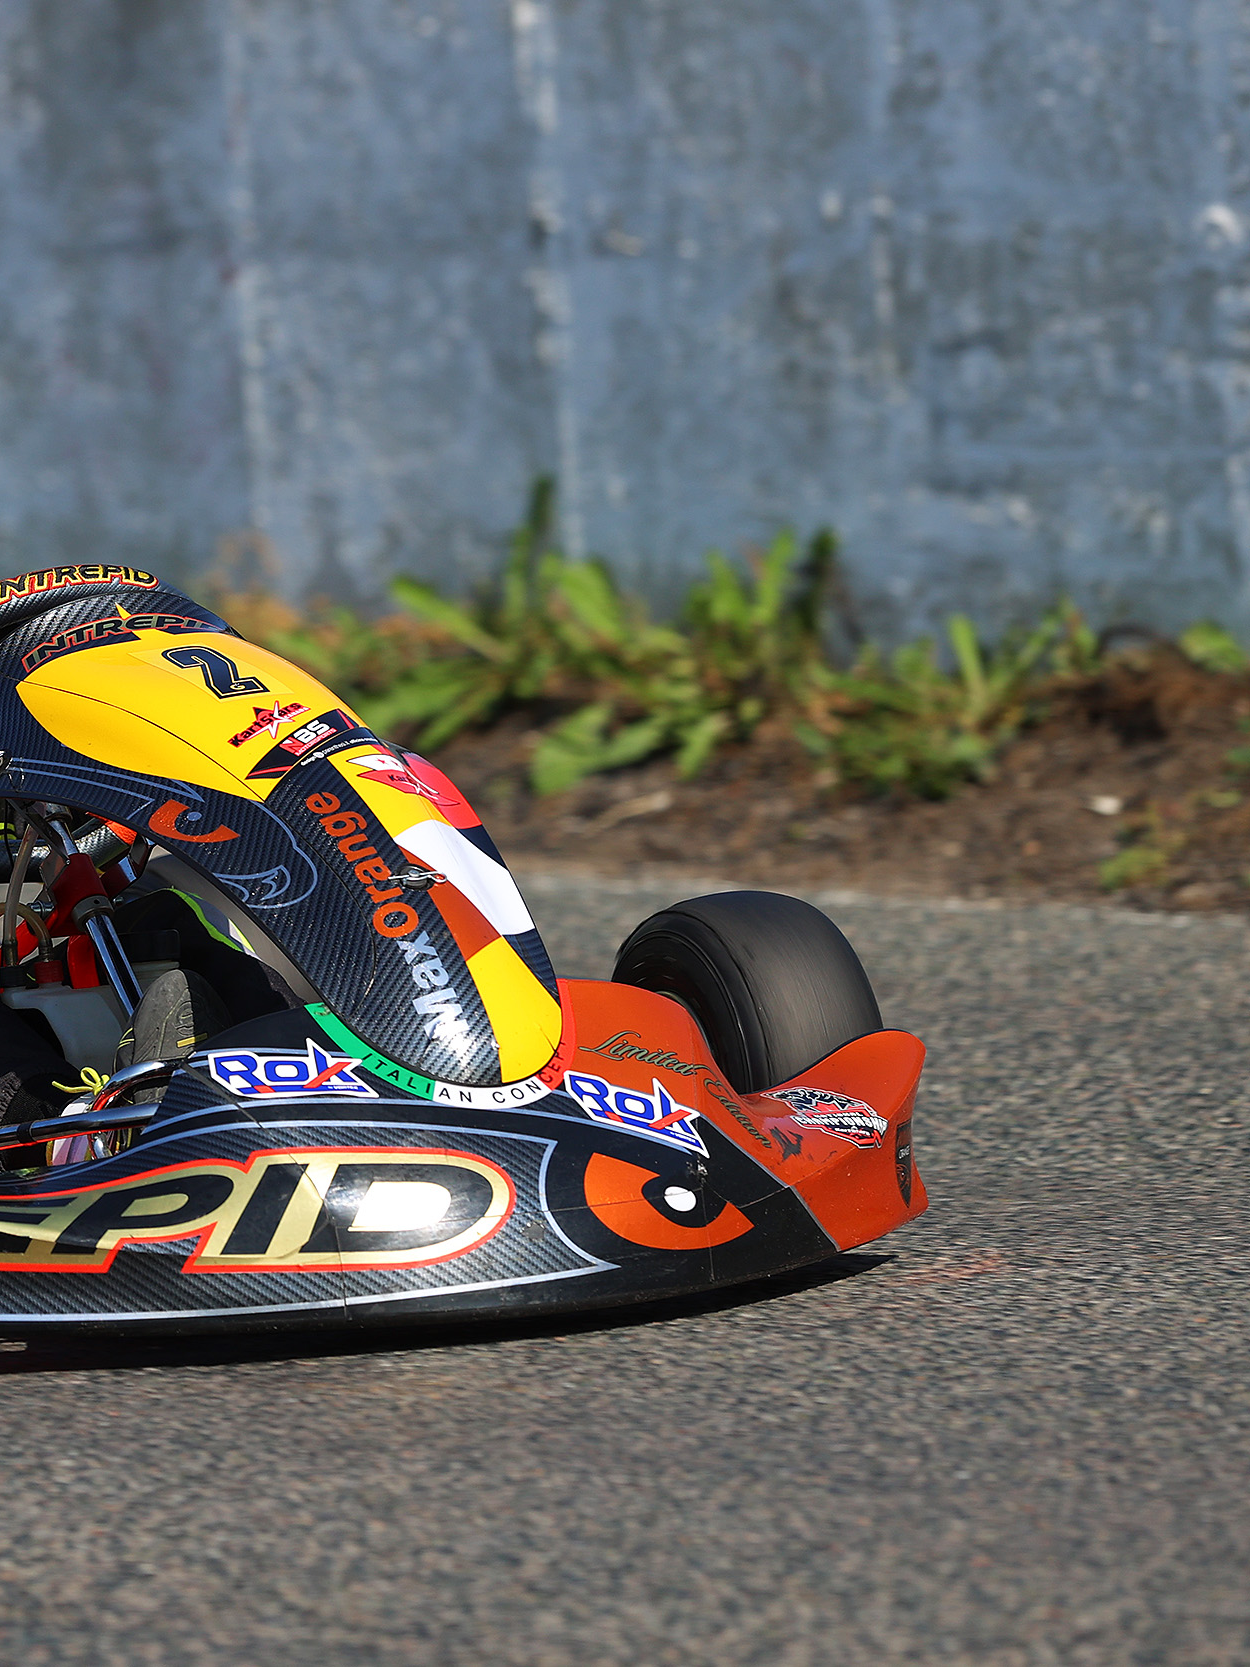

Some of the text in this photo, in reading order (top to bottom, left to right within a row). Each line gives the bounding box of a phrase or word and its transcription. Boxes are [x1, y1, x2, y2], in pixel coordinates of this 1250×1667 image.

[22, 612, 228, 674] INTREPI
[161, 645, 271, 700] 2
[279, 719, 332, 754] NBS
[360, 1053, 473, 1103] ITALIAN
